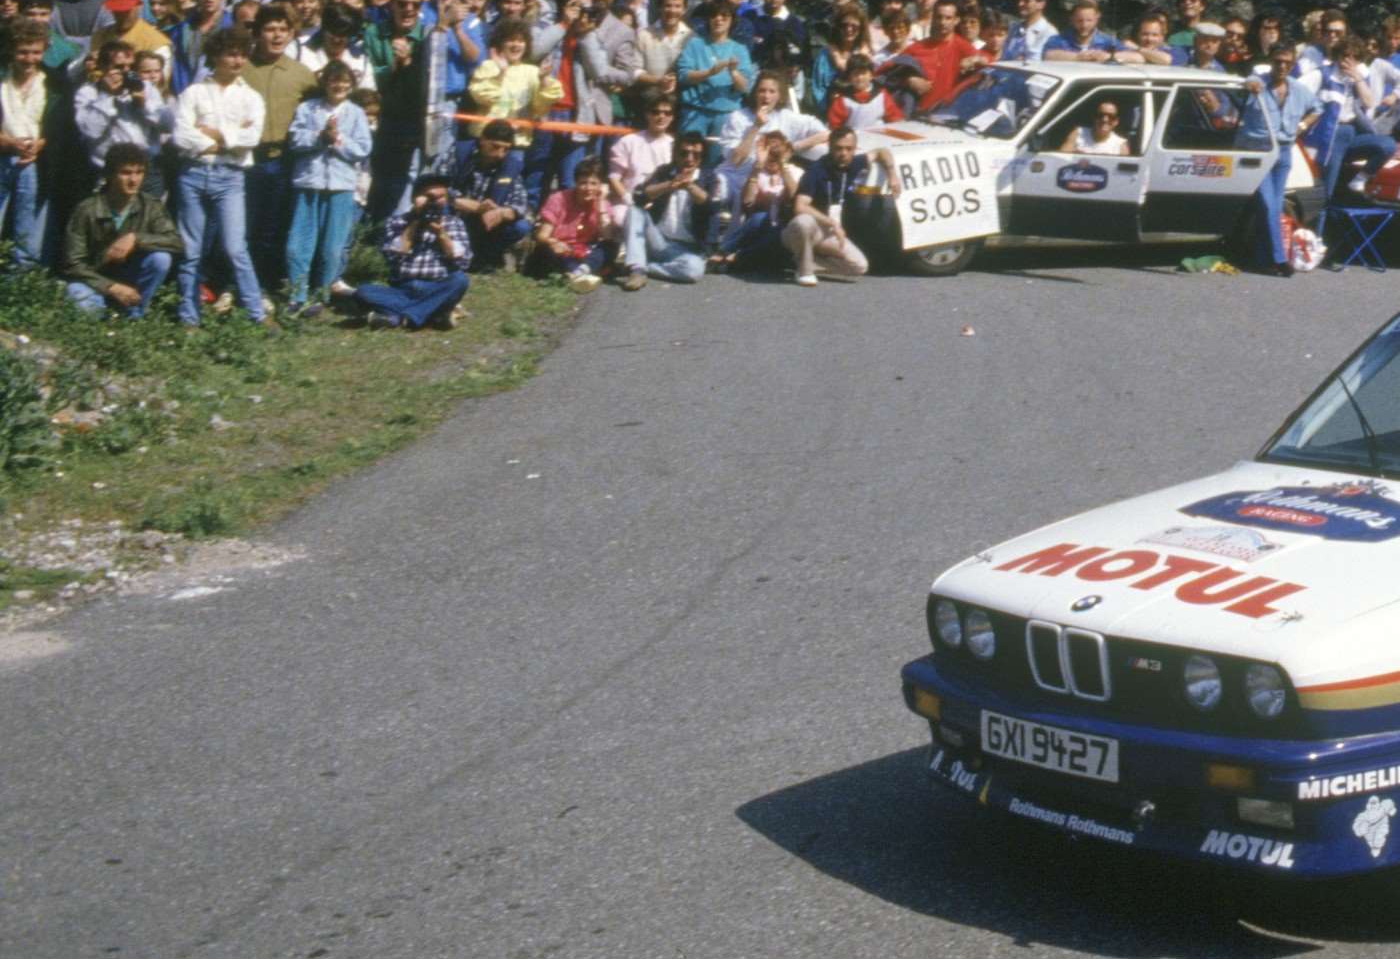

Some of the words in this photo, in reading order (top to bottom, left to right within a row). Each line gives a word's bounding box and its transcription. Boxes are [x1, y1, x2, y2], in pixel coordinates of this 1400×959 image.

[899, 151, 981, 190] RADIO
[910, 188, 981, 224] S.O.S
[992, 543, 1307, 619] MOTUL
[1008, 798, 1065, 826] Rothmans
[1067, 813, 1134, 844] Rothmans
[1201, 829, 1295, 869] MOTUL
